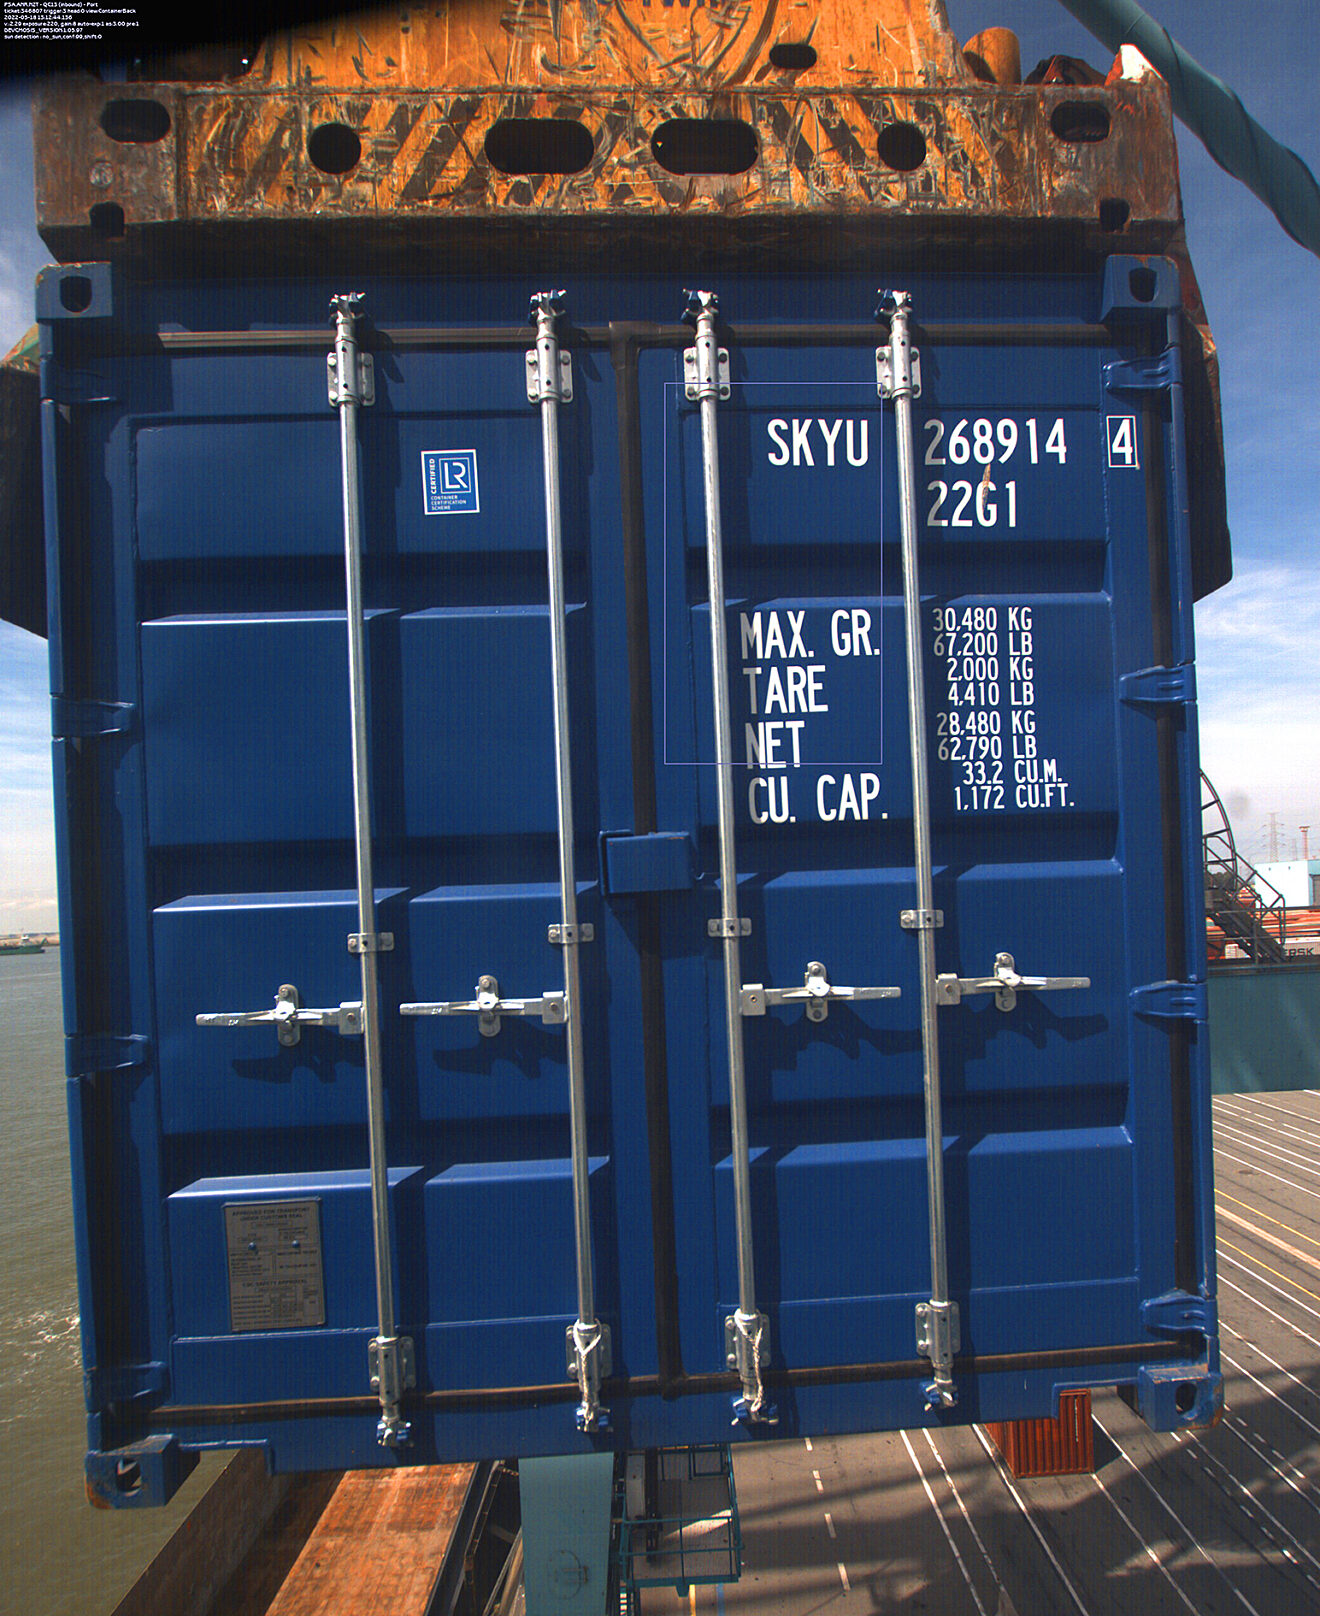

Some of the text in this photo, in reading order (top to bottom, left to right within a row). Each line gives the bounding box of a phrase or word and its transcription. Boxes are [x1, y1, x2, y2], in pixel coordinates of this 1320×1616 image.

[767, 418, 1133, 467] SKYU 268914 4
[429, 458, 437, 494] CERTIFIED
[444, 461, 469, 489] LR
[927, 480, 1017, 528] 22G1
[740, 606, 1033, 660] MAX. GR. 30,480 KG
[933, 631, 1033, 657] 67,200 LB
[742, 656, 1034, 715] TARE 2,000 KG
[948, 681, 1035, 706] 4,410 LB
[744, 710, 1036, 770] NET 28,480 KG
[937, 735, 1037, 761] 62,790 LB
[748, 758, 1063, 825] CU. CAP. 33.2 CU.M.
[954, 783, 1075, 811] 1,172 CU.FT.
